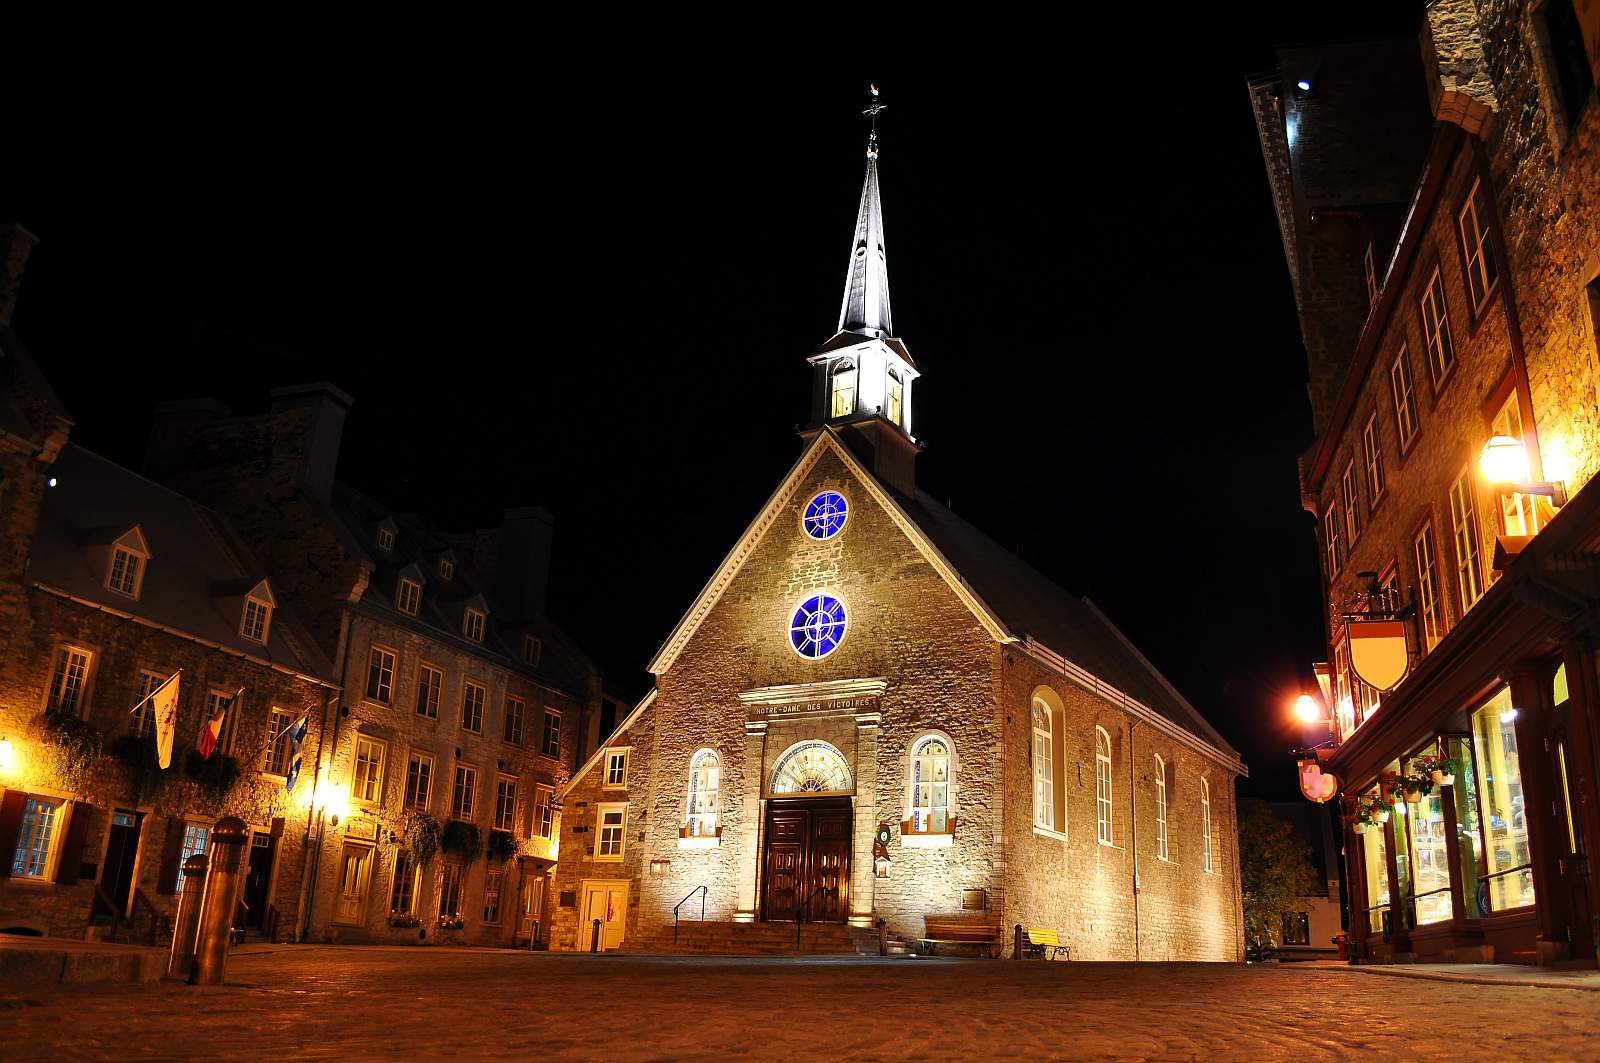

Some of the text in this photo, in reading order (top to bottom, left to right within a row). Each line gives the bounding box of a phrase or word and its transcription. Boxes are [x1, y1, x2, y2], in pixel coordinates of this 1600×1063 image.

[756, 699, 870, 715] NOTRE-DAME DES VICTOIRES
